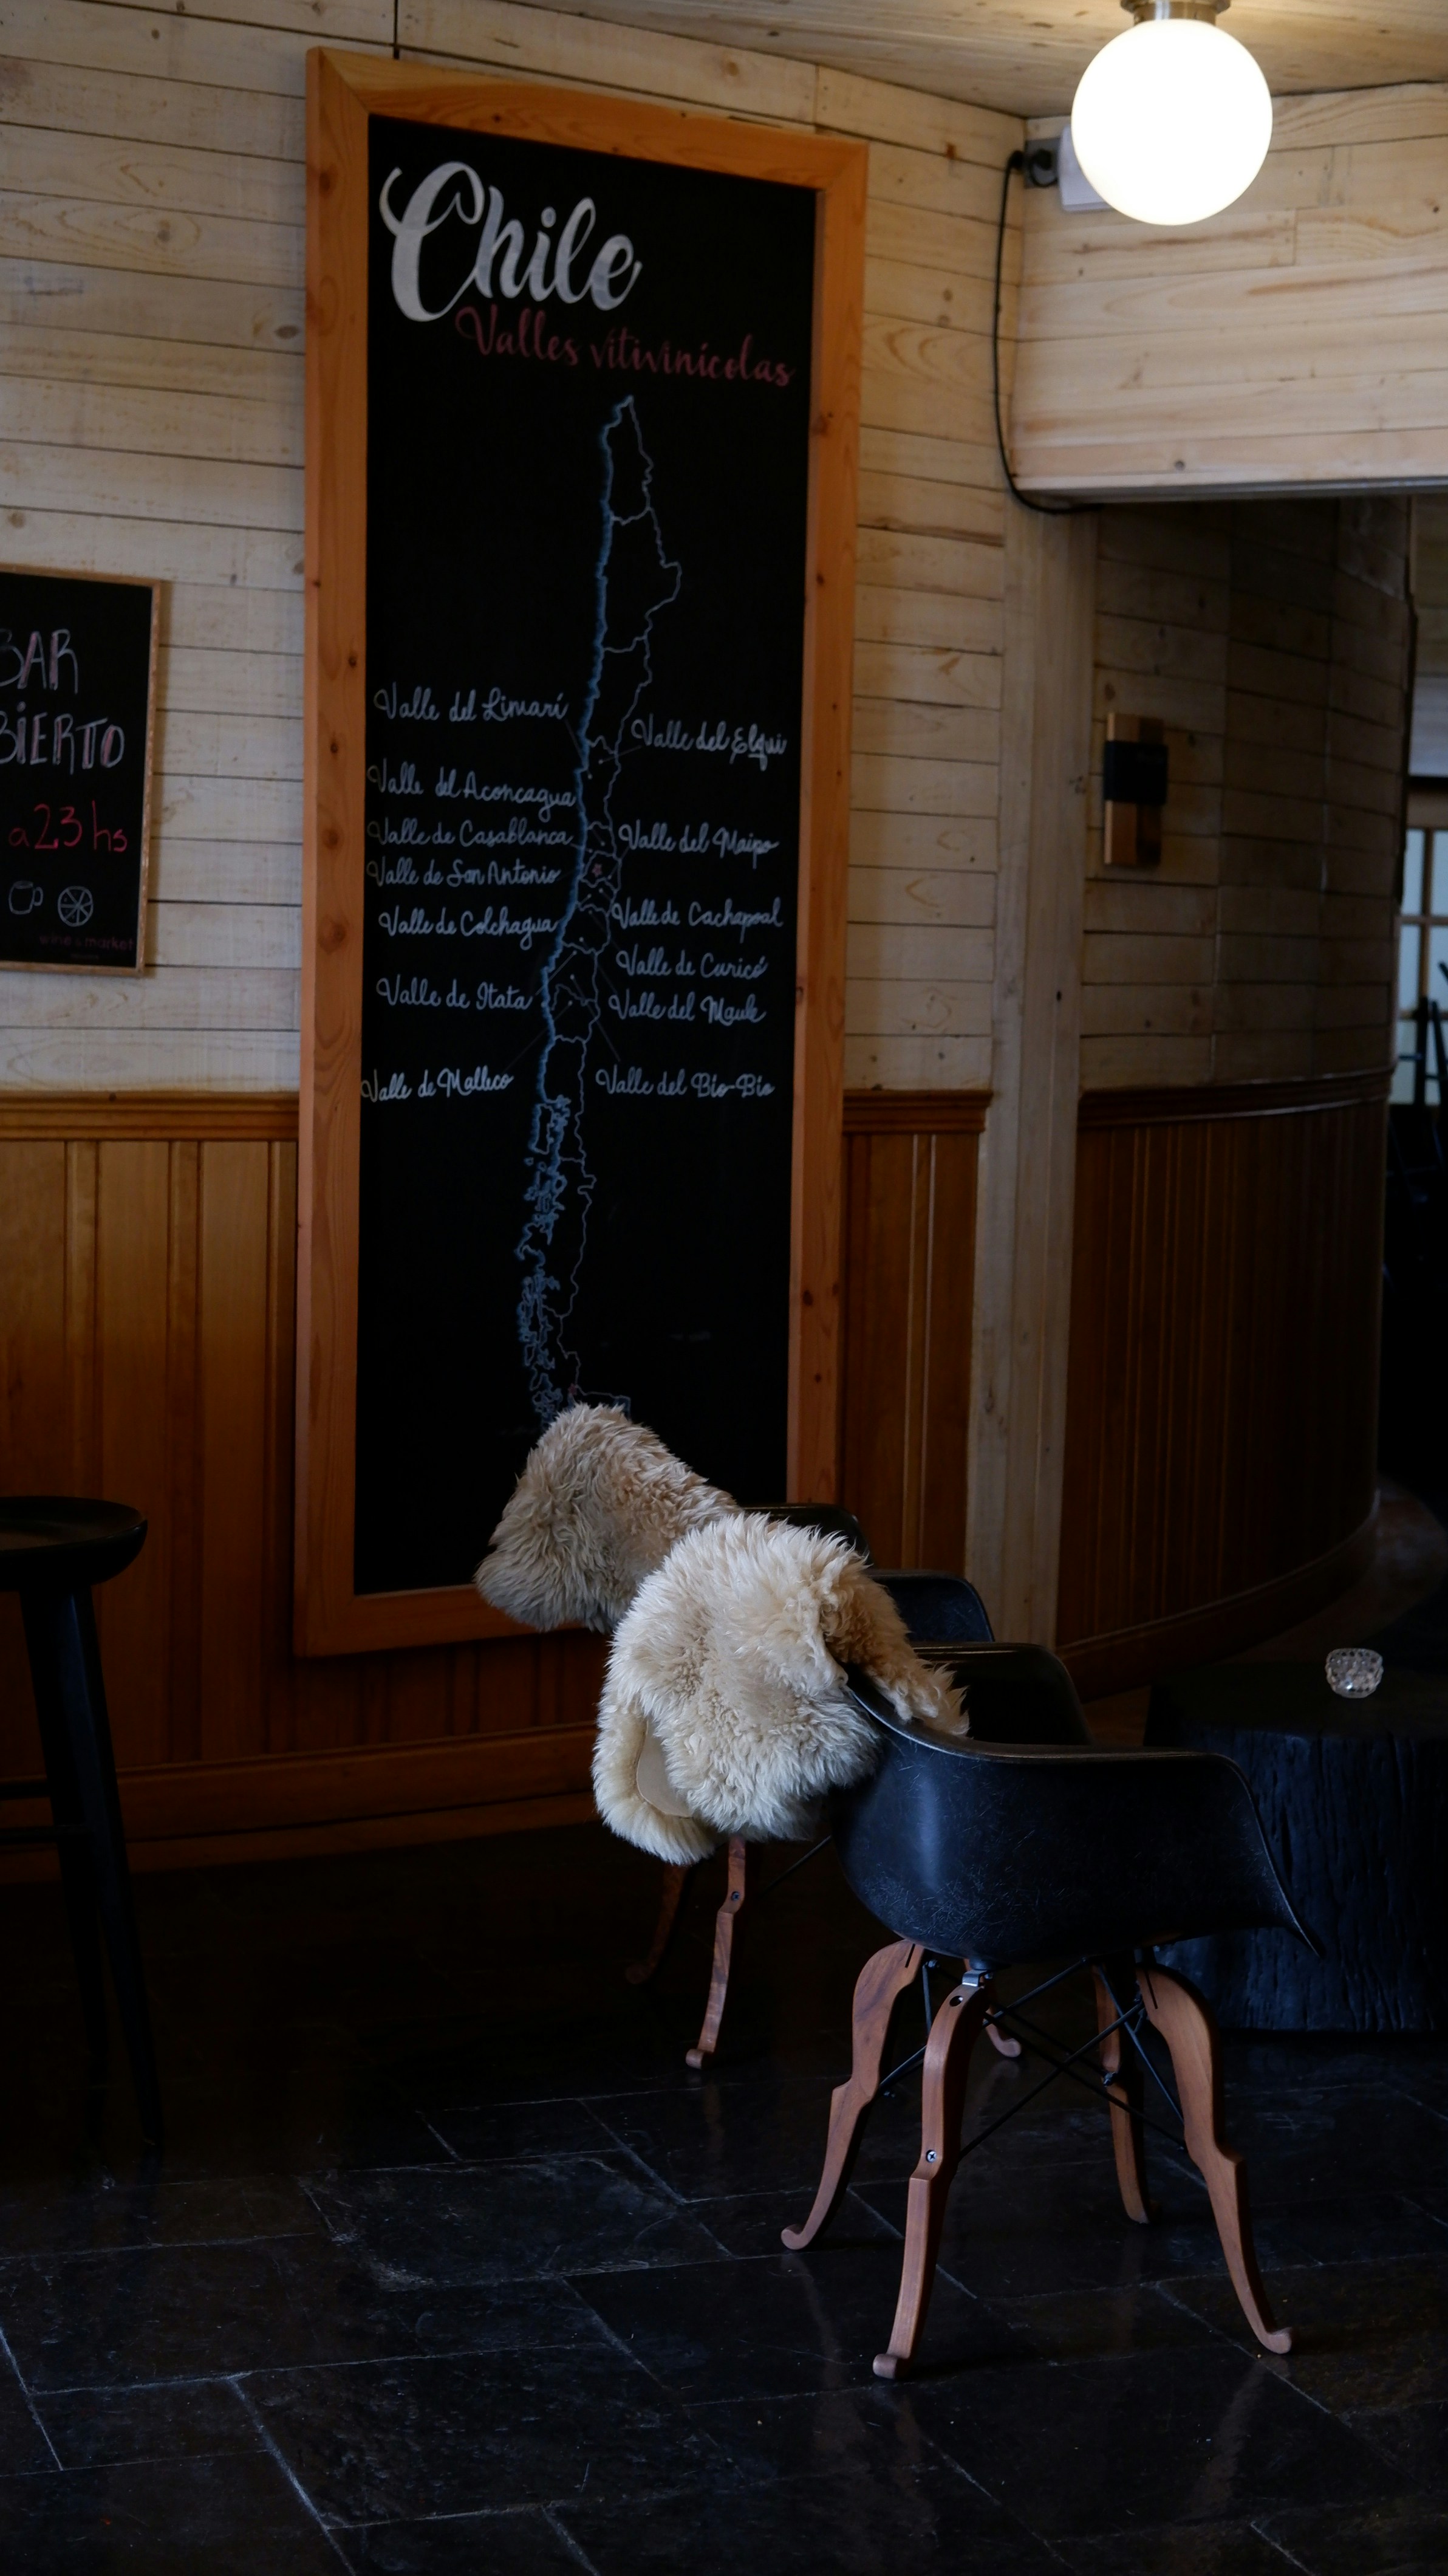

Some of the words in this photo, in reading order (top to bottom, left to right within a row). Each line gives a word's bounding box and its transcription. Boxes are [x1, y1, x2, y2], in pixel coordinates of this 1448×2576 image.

[379, 161, 643, 322] Chile
[455, 304, 578, 366] Valles
[373, 681, 440, 721] Valle
[449, 689, 477, 722] del
[630, 713, 695, 751] Valle
[695, 721, 730, 752] del
[729, 723, 788, 772] Elqui
[366, 758, 424, 794] Valle
[463, 770, 578, 823] Aconcagua
[366, 817, 431, 845] Valle
[432, 821, 456, 844] de
[459, 817, 574, 847] Casablanca
[618, 819, 677, 851] Valle
[679, 822, 710, 854] del
[712, 827, 780, 869] Maipo
[366, 855, 419, 888] Valle
[423, 858, 444, 885] de
[446, 859, 485, 888] San
[488, 858, 561, 885] Antonio
[378, 904, 434, 936] Valle
[435, 906, 457, 934] de
[460, 906, 559, 951] Colchagua
[611, 897, 661, 930] Valle
[660, 899, 681, 926] de
[688, 896, 784, 944] Cachapoal
[616, 943, 672, 976] Valle
[675, 949, 697, 976] de
[376, 973, 442, 1006] Valle
[446, 979, 471, 1009] de
[476, 981, 533, 1010] Itata
[608, 988, 666, 1020] Valle
[668, 991, 695, 1022] del
[700, 993, 767, 1026] Maule
[360, 1068, 412, 1102] Valle
[418, 1069, 437, 1098] de
[437, 1065, 514, 1098] Malleco
[595, 1064, 654, 1095] Valle
[657, 1068, 688, 1095] del
